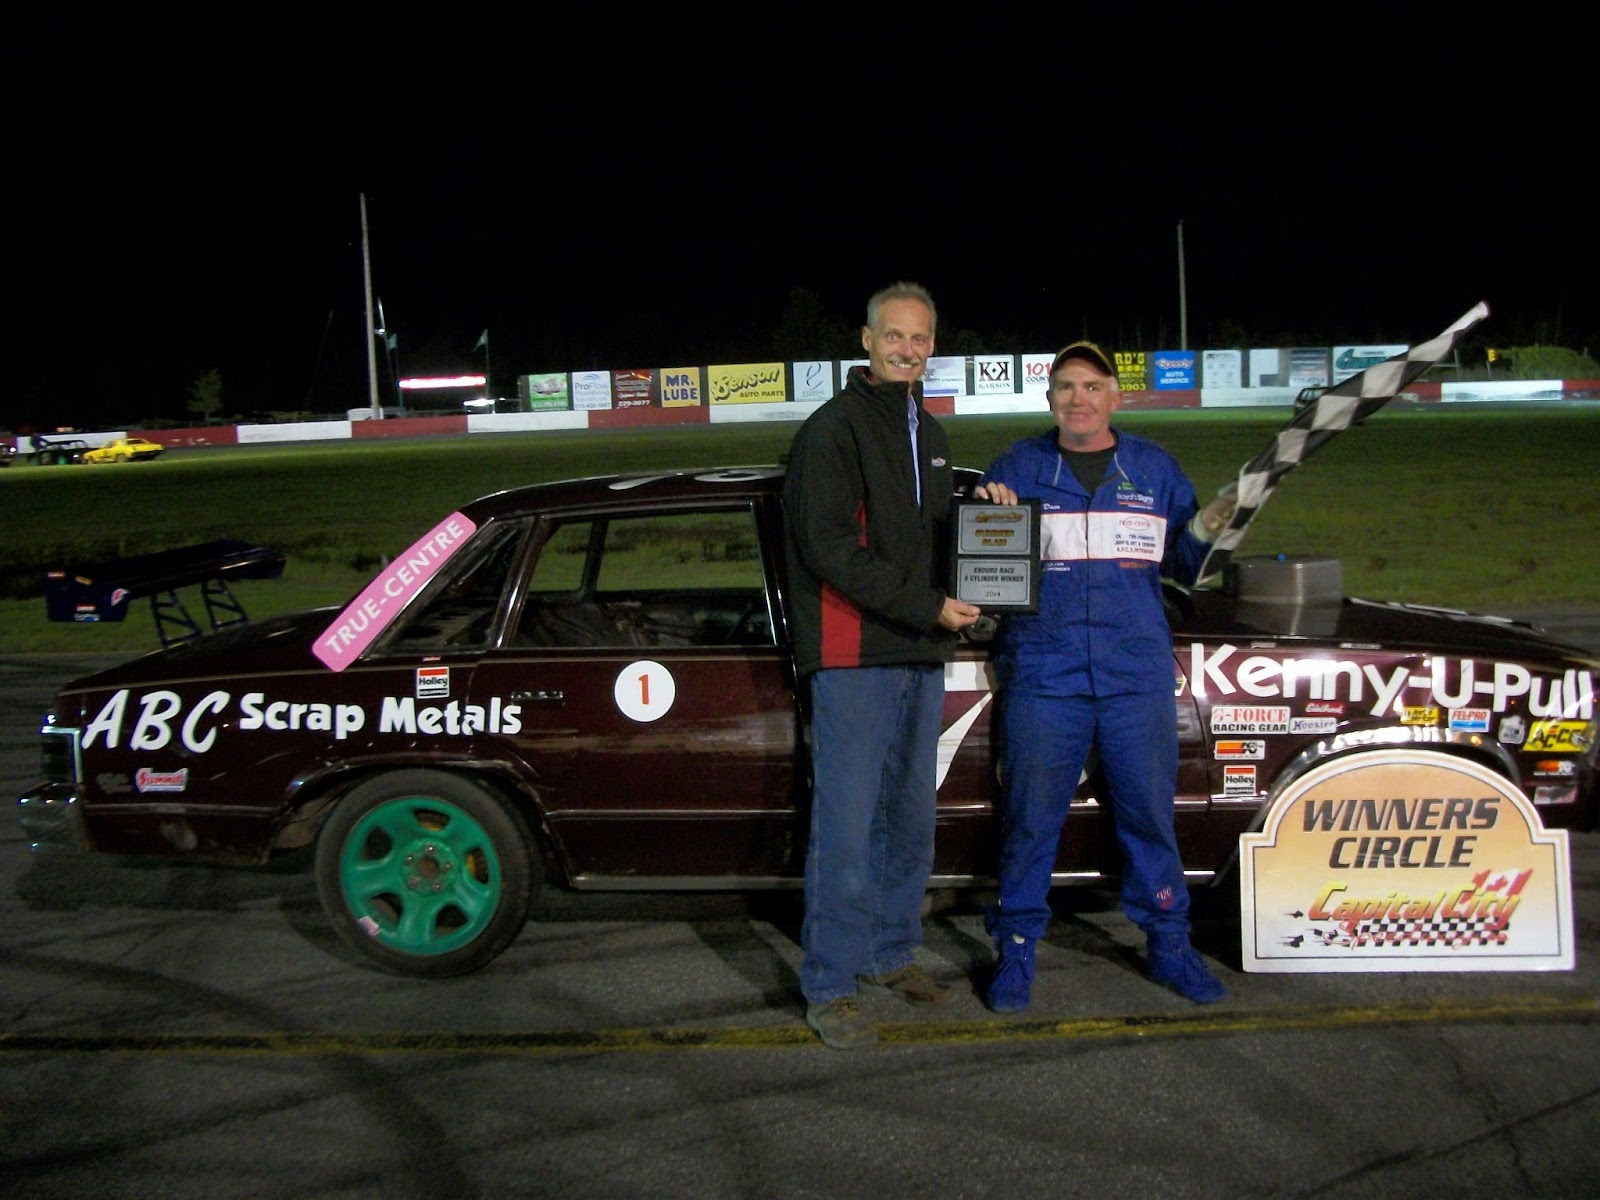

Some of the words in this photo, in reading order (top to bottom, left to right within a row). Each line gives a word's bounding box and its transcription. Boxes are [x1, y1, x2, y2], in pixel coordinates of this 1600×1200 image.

[663, 388, 698, 401] LUBE
[666, 375, 695, 387] MR.
[711, 367, 780, 401] Benson
[325, 520, 464, 655] TRUE-CENTRE
[418, 677, 448, 687] Holley
[638, 673, 649, 705] 1
[1191, 643, 1593, 719] Kenny-U-Pull
[81, 689, 231, 753] ABC
[239, 693, 365, 740] Scrap
[379, 697, 522, 736] Metals
[1213, 724, 1255, 732] RACING
[1225, 775, 1255, 786] Holley
[1302, 798, 1500, 832] WINNERS
[1328, 835, 1478, 869] CIRCLE
[1308, 881, 1446, 936] Capital
[1441, 884, 1521, 930] City
